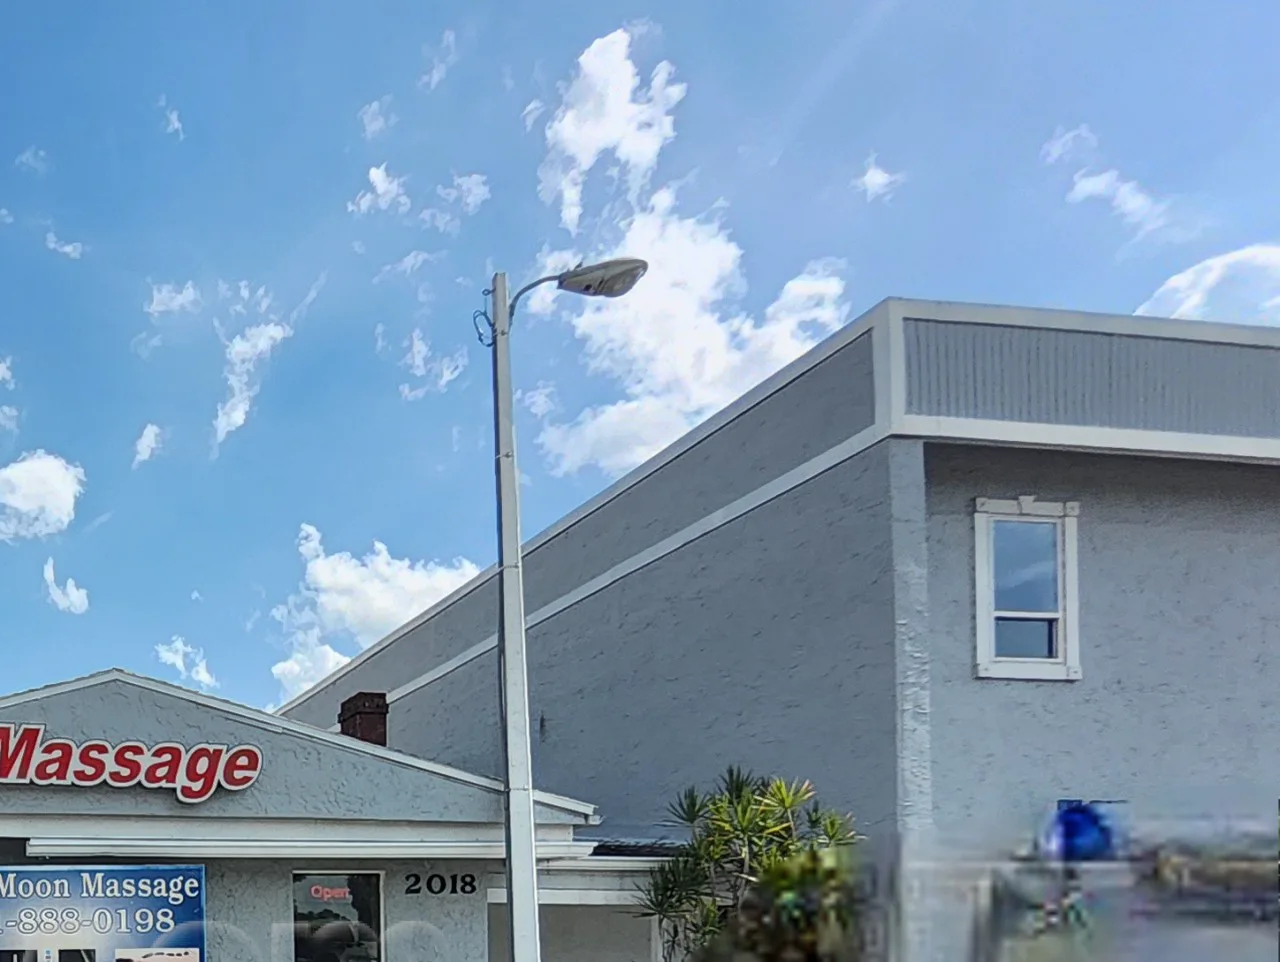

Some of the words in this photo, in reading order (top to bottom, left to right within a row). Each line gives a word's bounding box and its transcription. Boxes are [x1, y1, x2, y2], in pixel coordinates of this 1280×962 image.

[80, 872, 200, 905] Massage
[310, 885, 351, 899] Open
[404, 873, 477, 895] 2018
